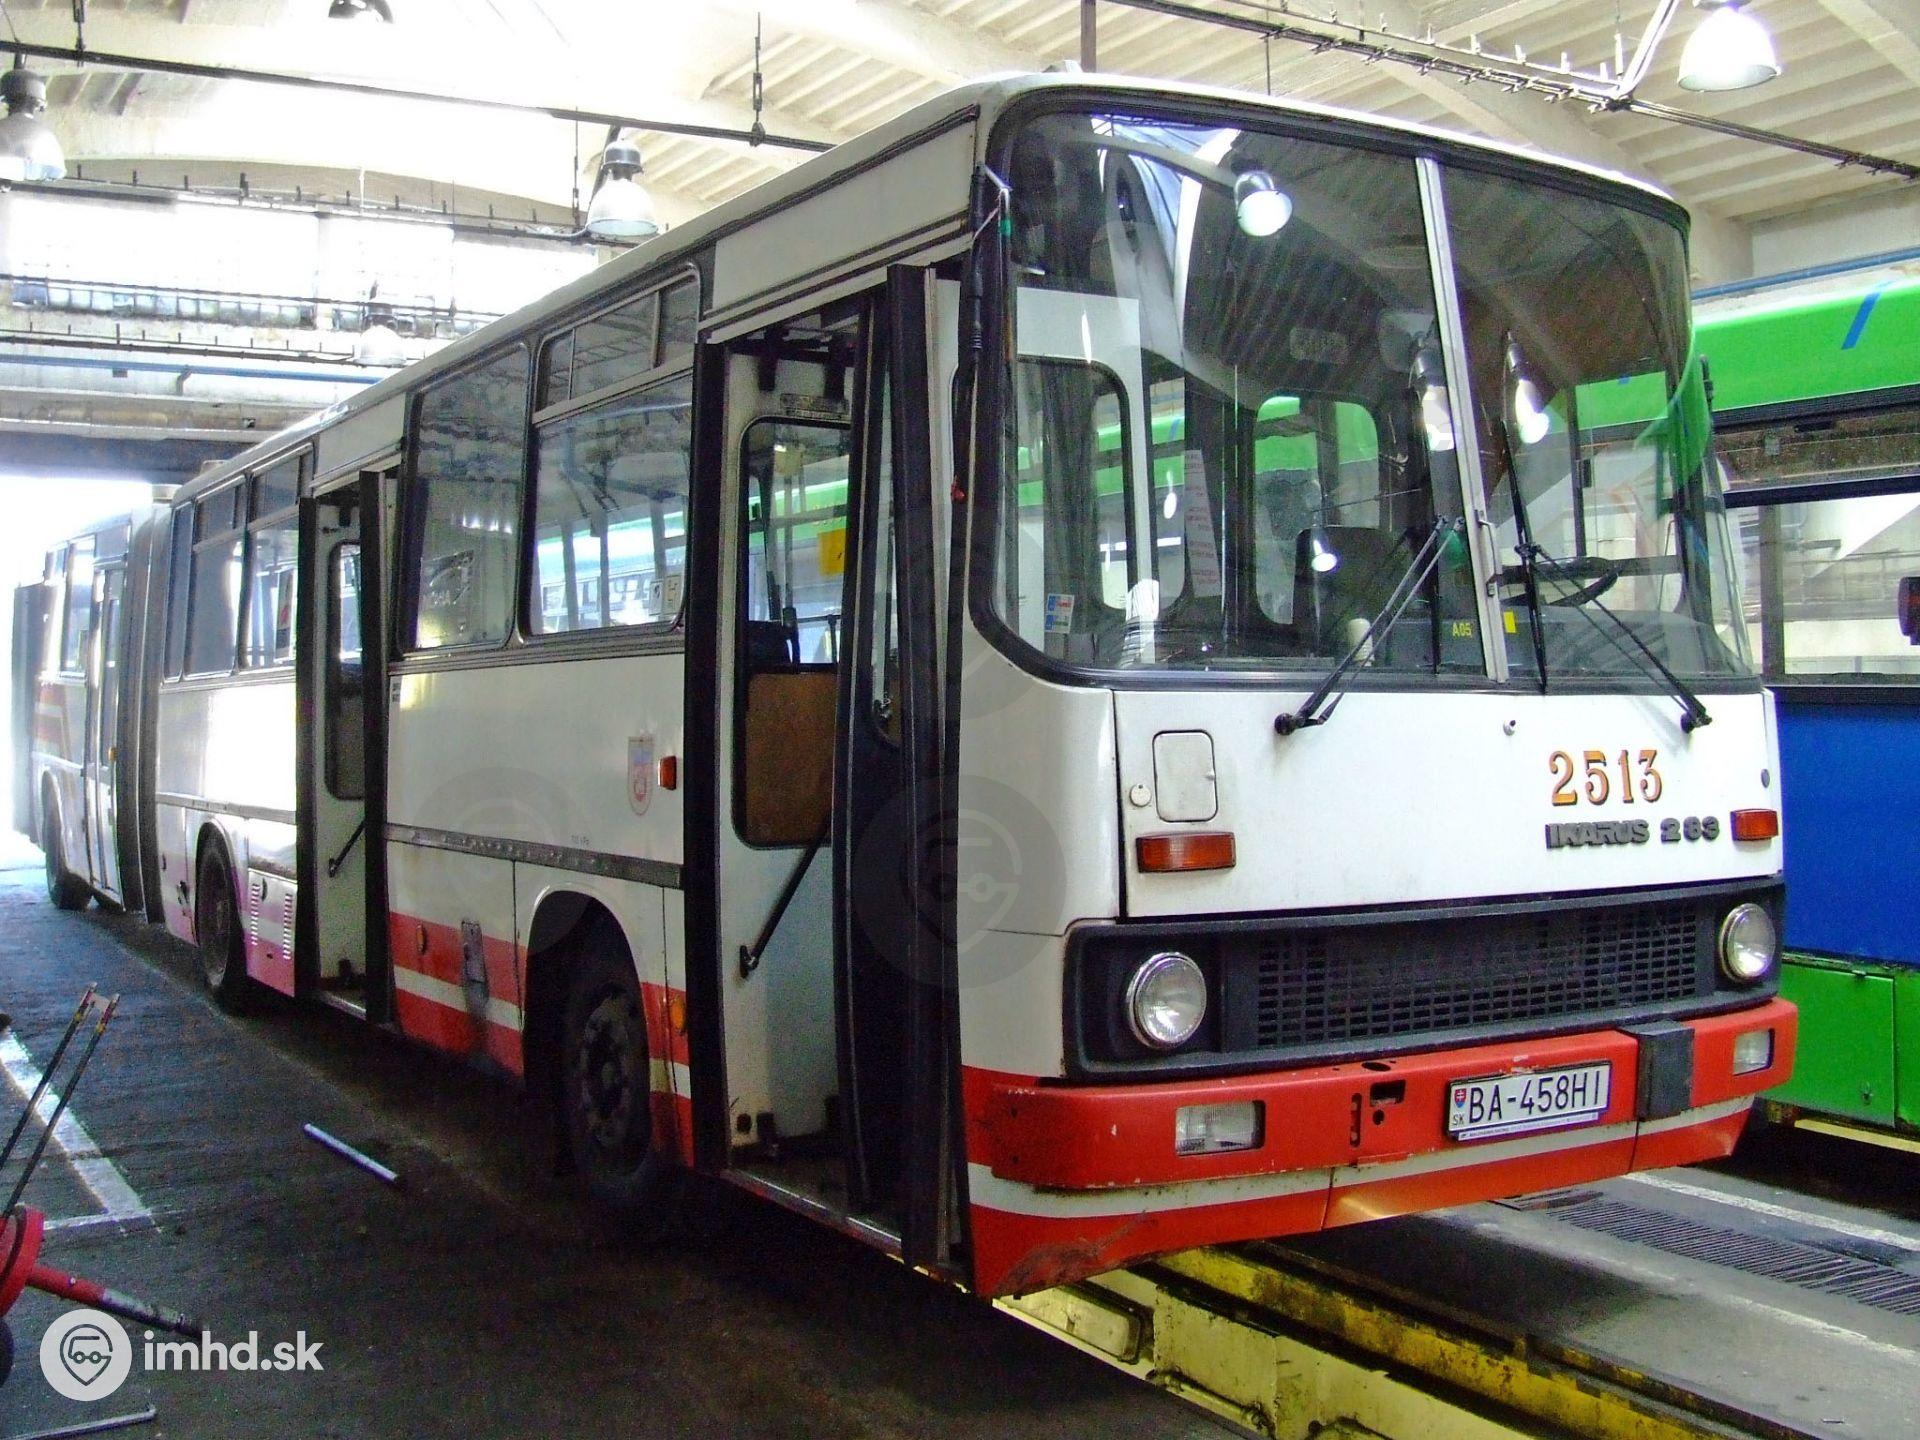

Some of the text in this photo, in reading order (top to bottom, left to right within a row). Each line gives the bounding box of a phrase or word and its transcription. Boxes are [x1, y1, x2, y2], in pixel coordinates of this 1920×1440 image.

[1549, 750, 1662, 806] 2513
[1545, 819, 1650, 849] IKARUS
[1469, 1070, 1600, 1124] BA-458HI
[1452, 1112, 1465, 1126] SK
